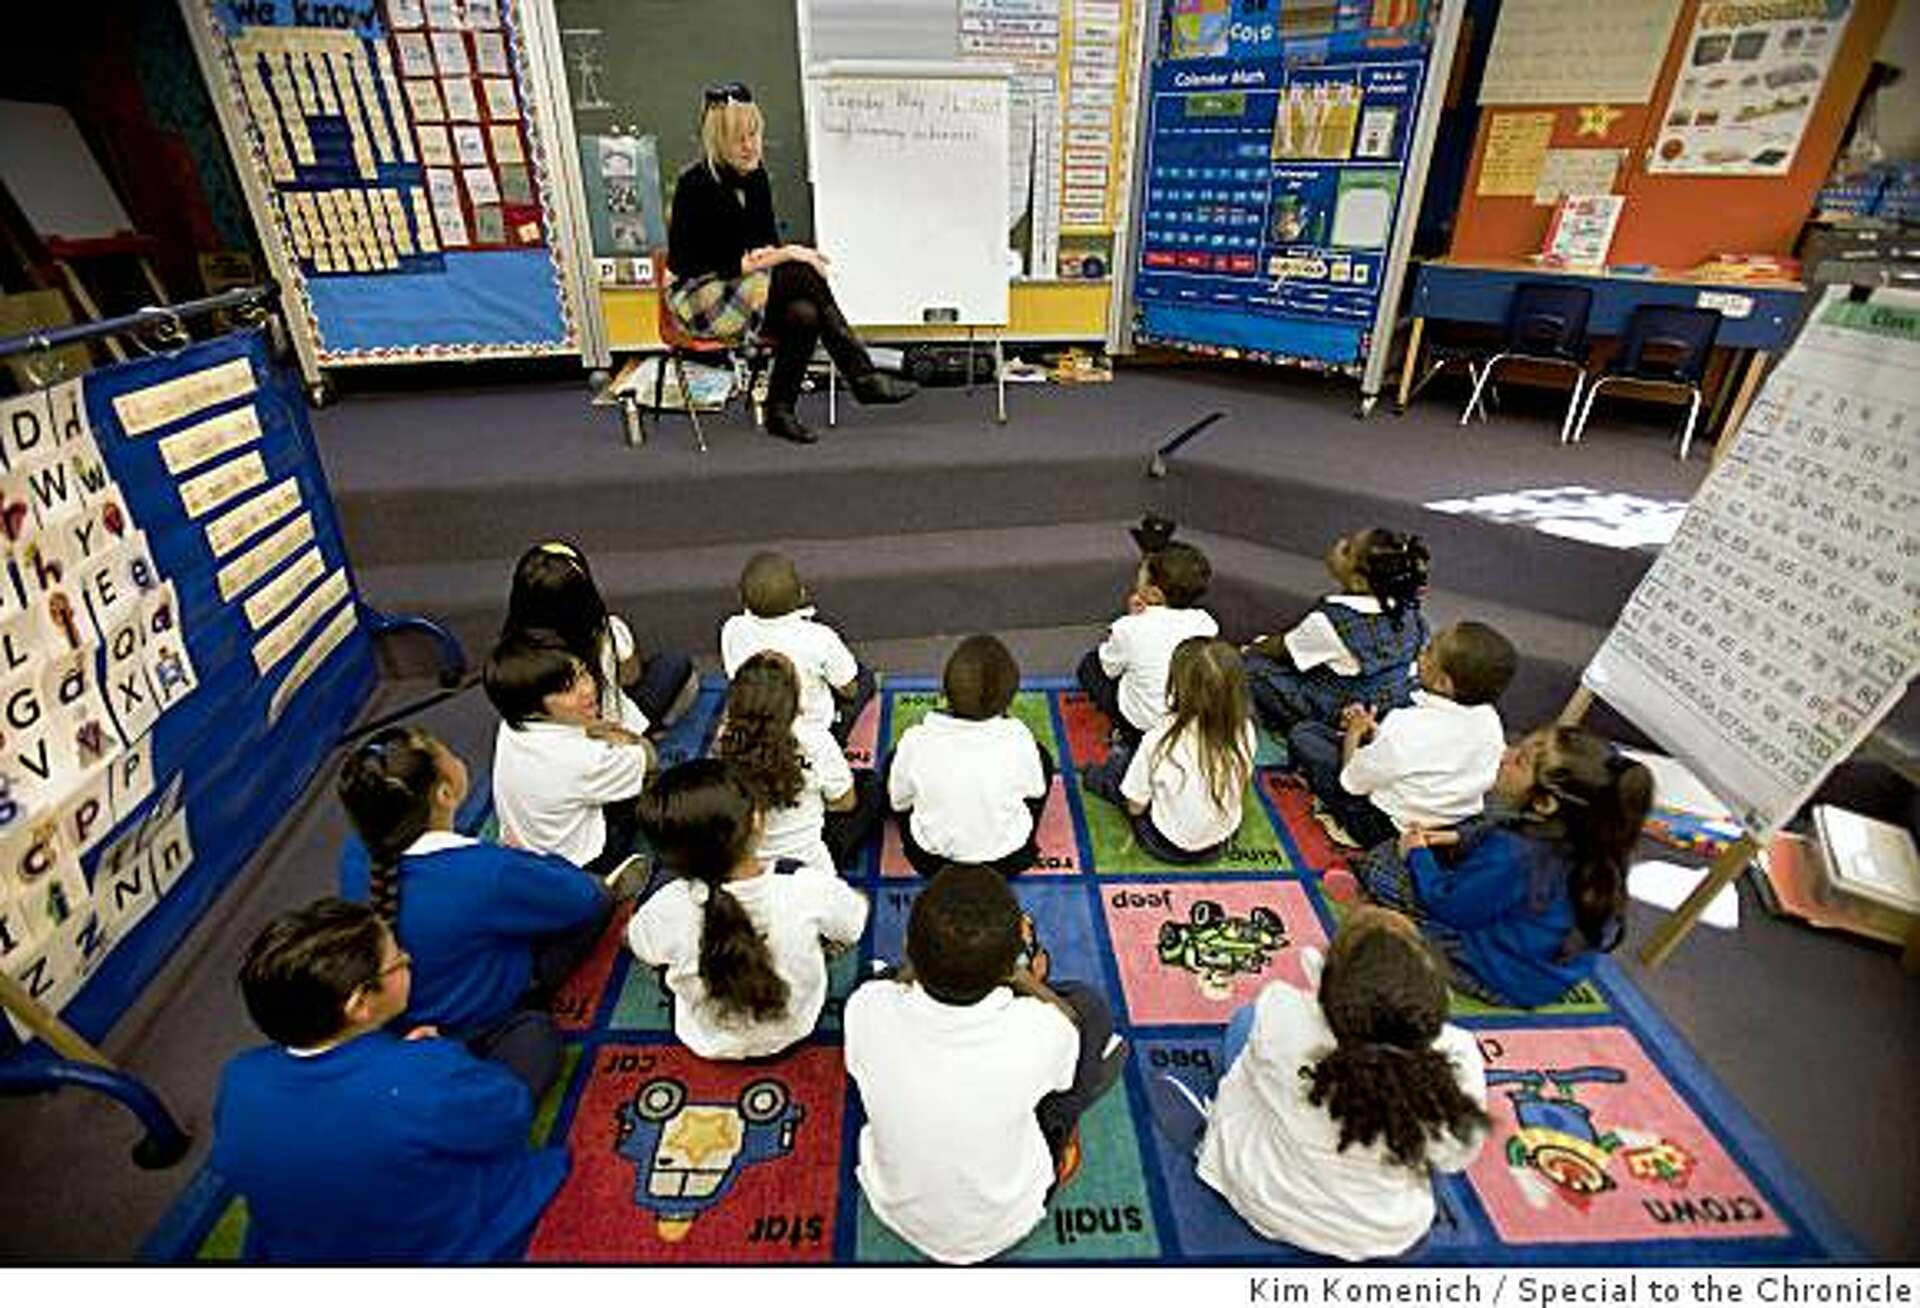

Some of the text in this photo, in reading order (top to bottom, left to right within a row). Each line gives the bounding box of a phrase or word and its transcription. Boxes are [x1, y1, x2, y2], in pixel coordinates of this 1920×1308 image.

[1174, 70, 1266, 86] Calendar Math
[12, 410, 41, 450] D
[29, 463, 67, 508] W
[75, 519, 94, 557] Y
[33, 548, 63, 590] h
[95, 568, 118, 606] E
[3, 634, 28, 670] L
[6, 688, 41, 730] G
[118, 674, 143, 714] X
[19, 738, 49, 780] V
[164, 840, 183, 872] n
[115, 867, 142, 911] N
[1112, 889, 1173, 913] jeep
[19, 956, 55, 998] Z
[603, 1054, 657, 1075] car
[1055, 1205, 1143, 1246] snail
[1643, 1195, 1764, 1226] crown
[748, 1214, 824, 1248] star
